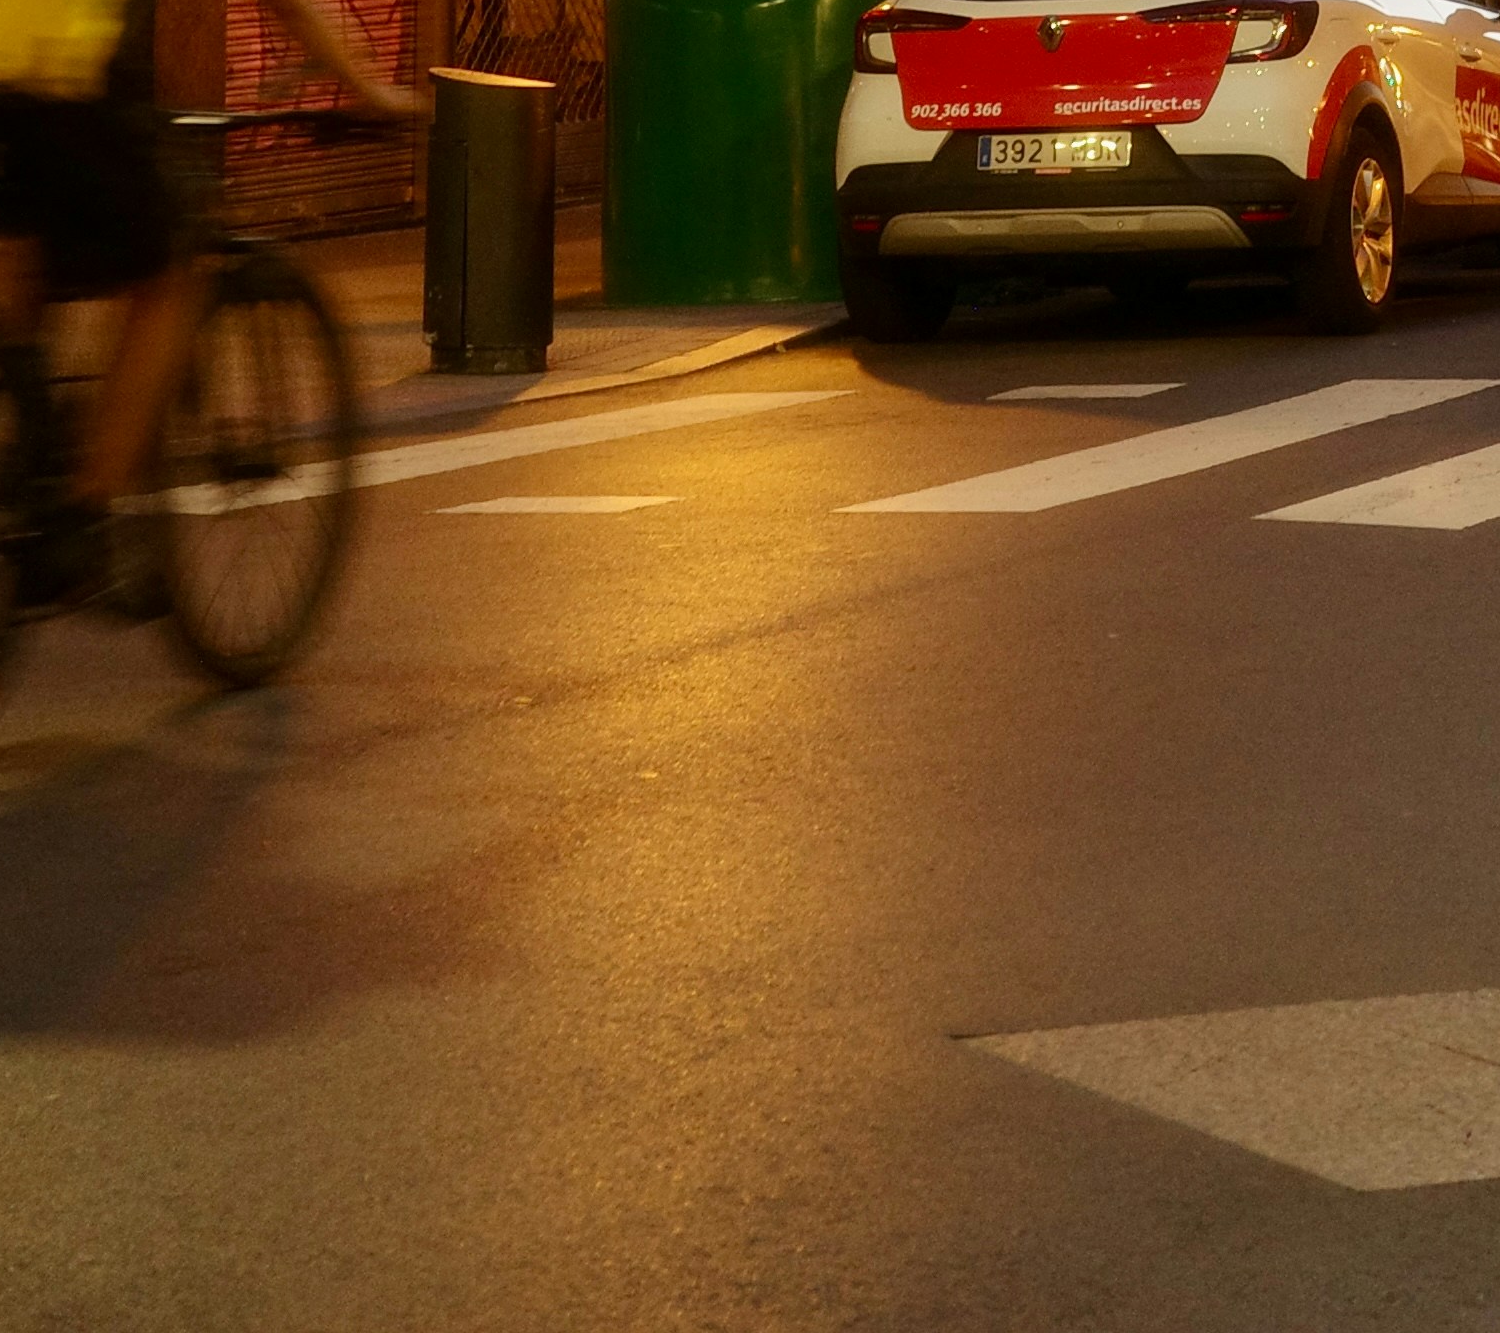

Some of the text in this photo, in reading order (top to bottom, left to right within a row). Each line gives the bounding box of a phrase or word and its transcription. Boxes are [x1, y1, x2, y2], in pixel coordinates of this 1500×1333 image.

[911, 102, 1002, 118] 902 366 366
[1054, 95, 1202, 115] securitasdirect.es
[994, 138, 1058, 164] 3921
